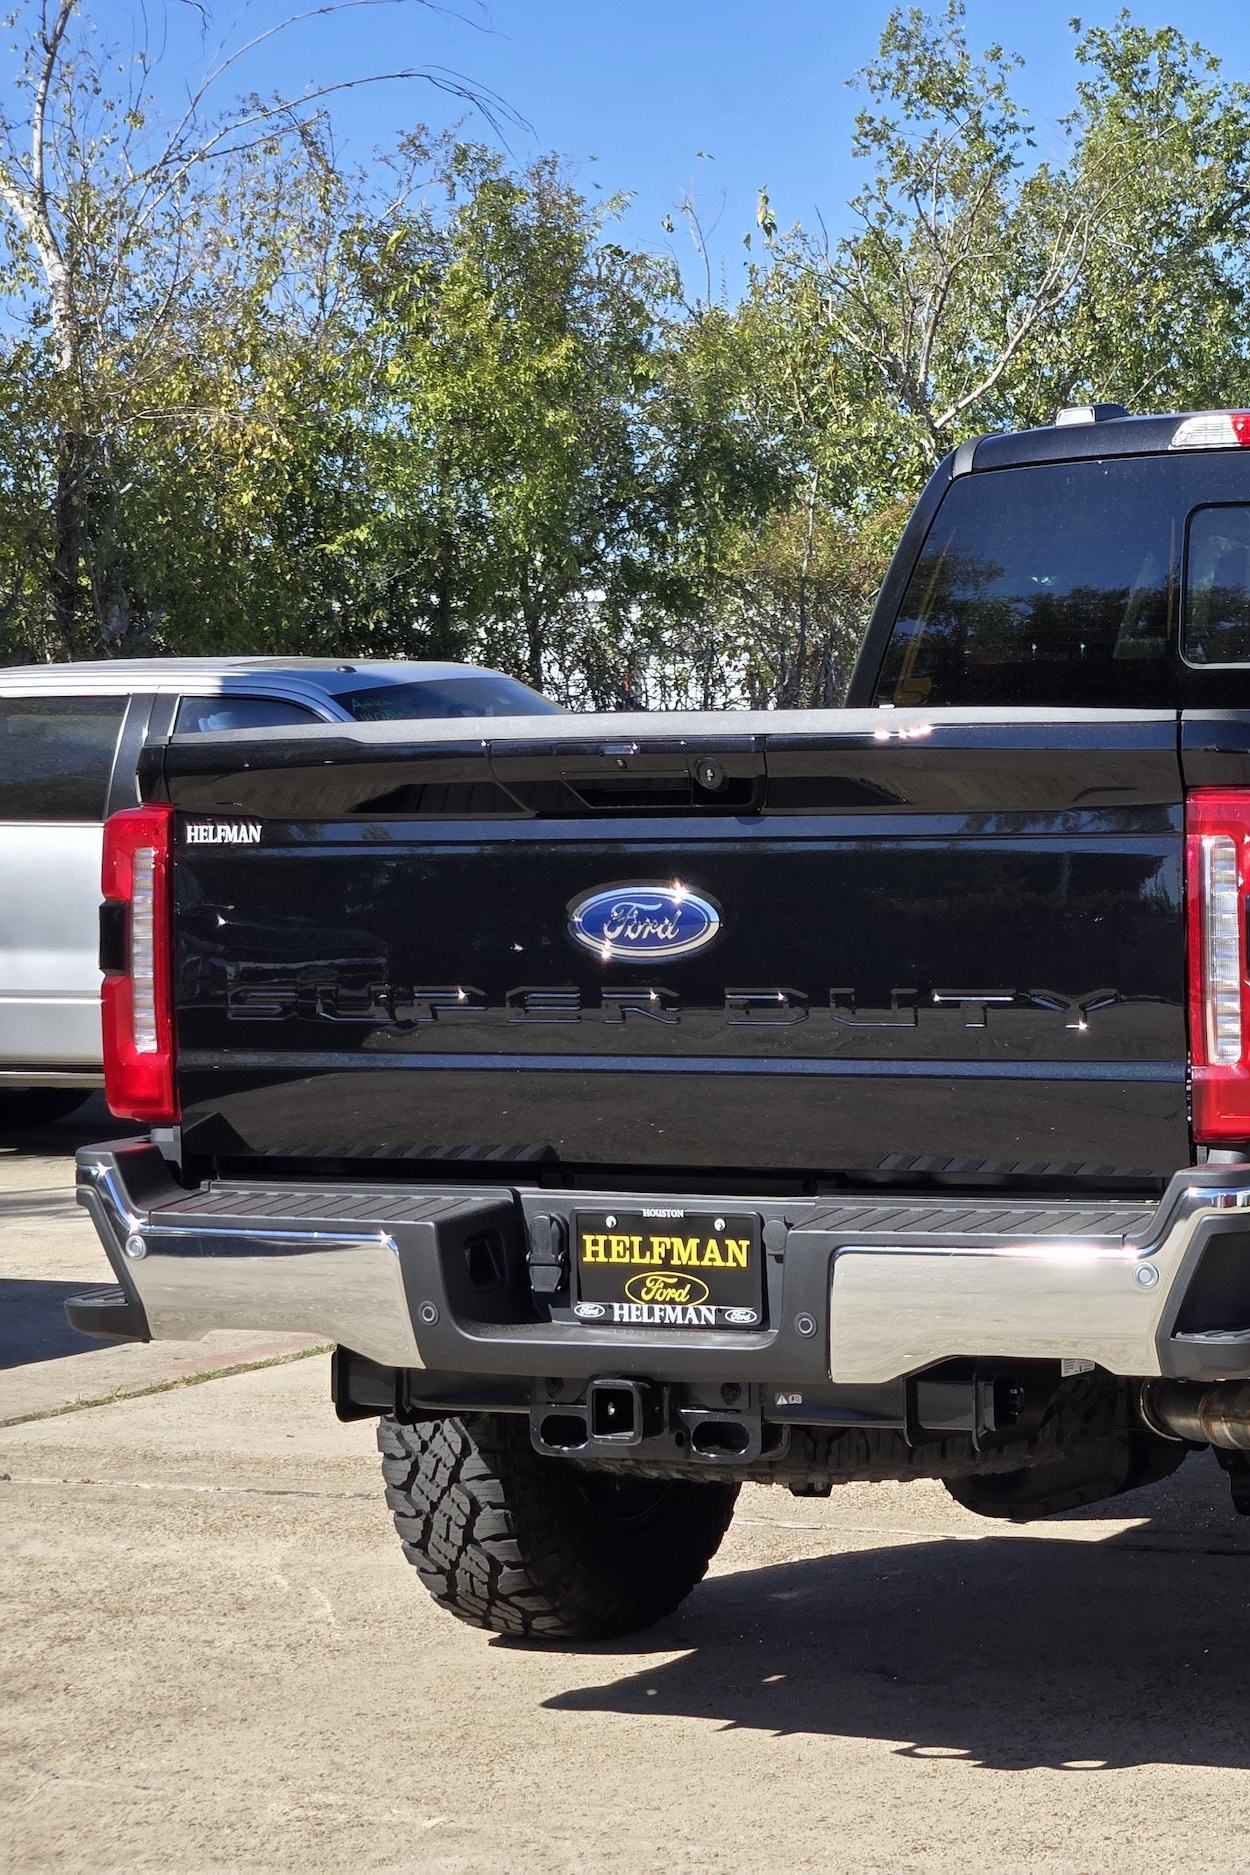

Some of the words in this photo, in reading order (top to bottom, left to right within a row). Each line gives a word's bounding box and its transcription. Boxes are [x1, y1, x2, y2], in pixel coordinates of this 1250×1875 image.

[185, 824, 262, 844] HELFMAN
[603, 902, 684, 940] Ford
[227, 985, 680, 1024] SUPER
[724, 987, 1118, 1029] DUTY
[642, 1208, 685, 1218] HOUSTON
[582, 1234, 751, 1268] HELFMAN
[640, 1275, 692, 1302] Ford
[612, 1302, 716, 1325] HELFMAN
